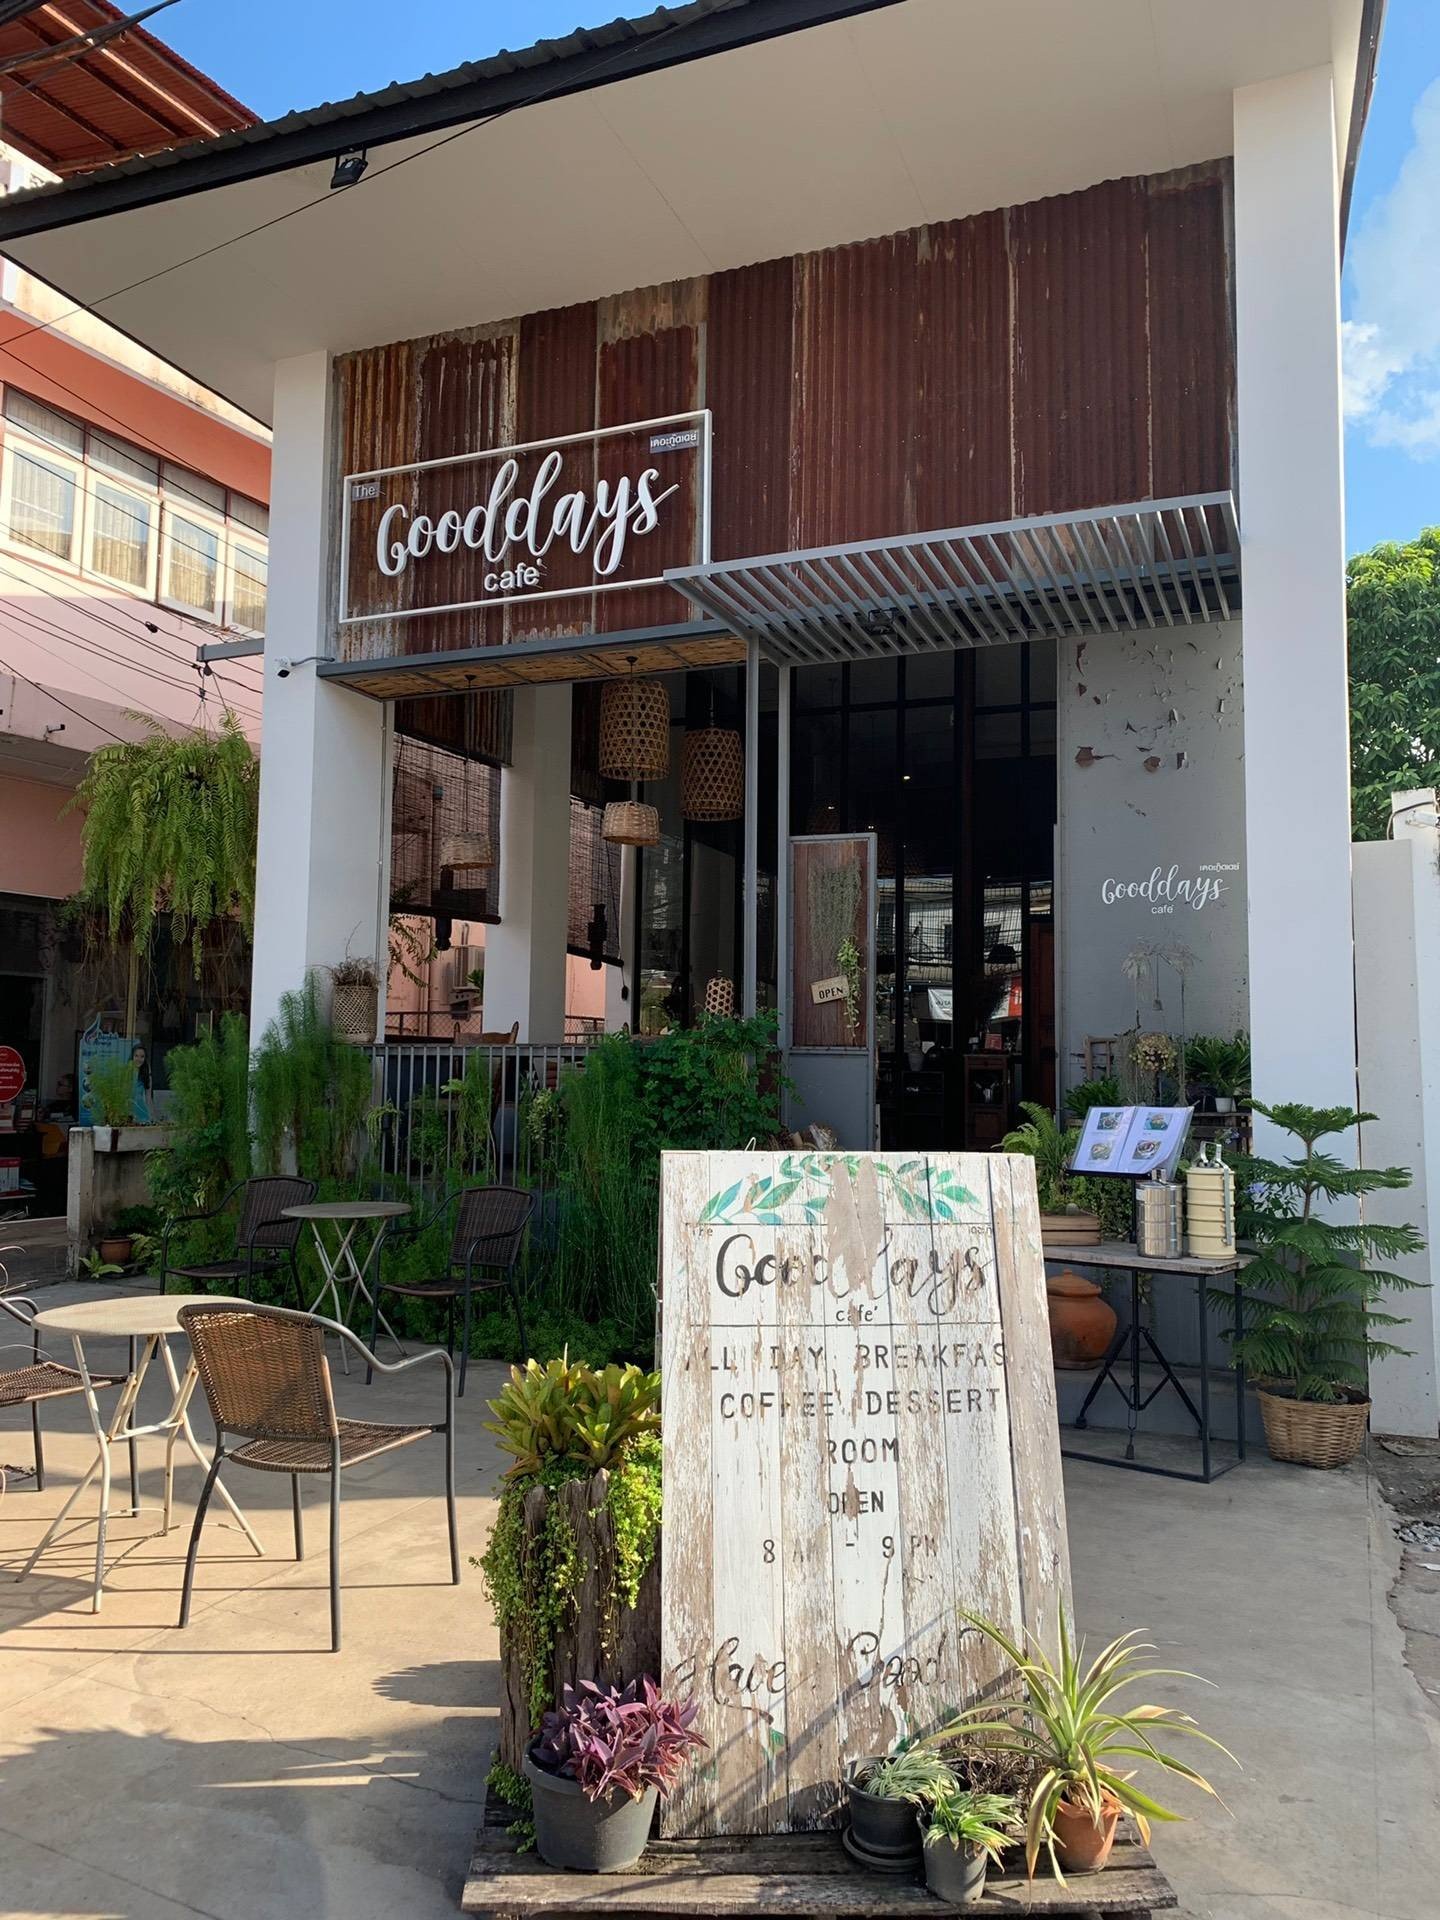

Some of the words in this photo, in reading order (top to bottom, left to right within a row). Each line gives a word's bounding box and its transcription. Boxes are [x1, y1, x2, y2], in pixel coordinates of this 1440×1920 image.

[354, 485, 376, 497] The
[376, 450, 680, 577] Gooddays
[1101, 864, 1231, 911] Gooddays
[818, 986, 844, 1000] OPEN
[821, 1438, 899, 1464] ROOM
[763, 1539, 775, 1563] 8
[882, 1536, 895, 1558] 9
